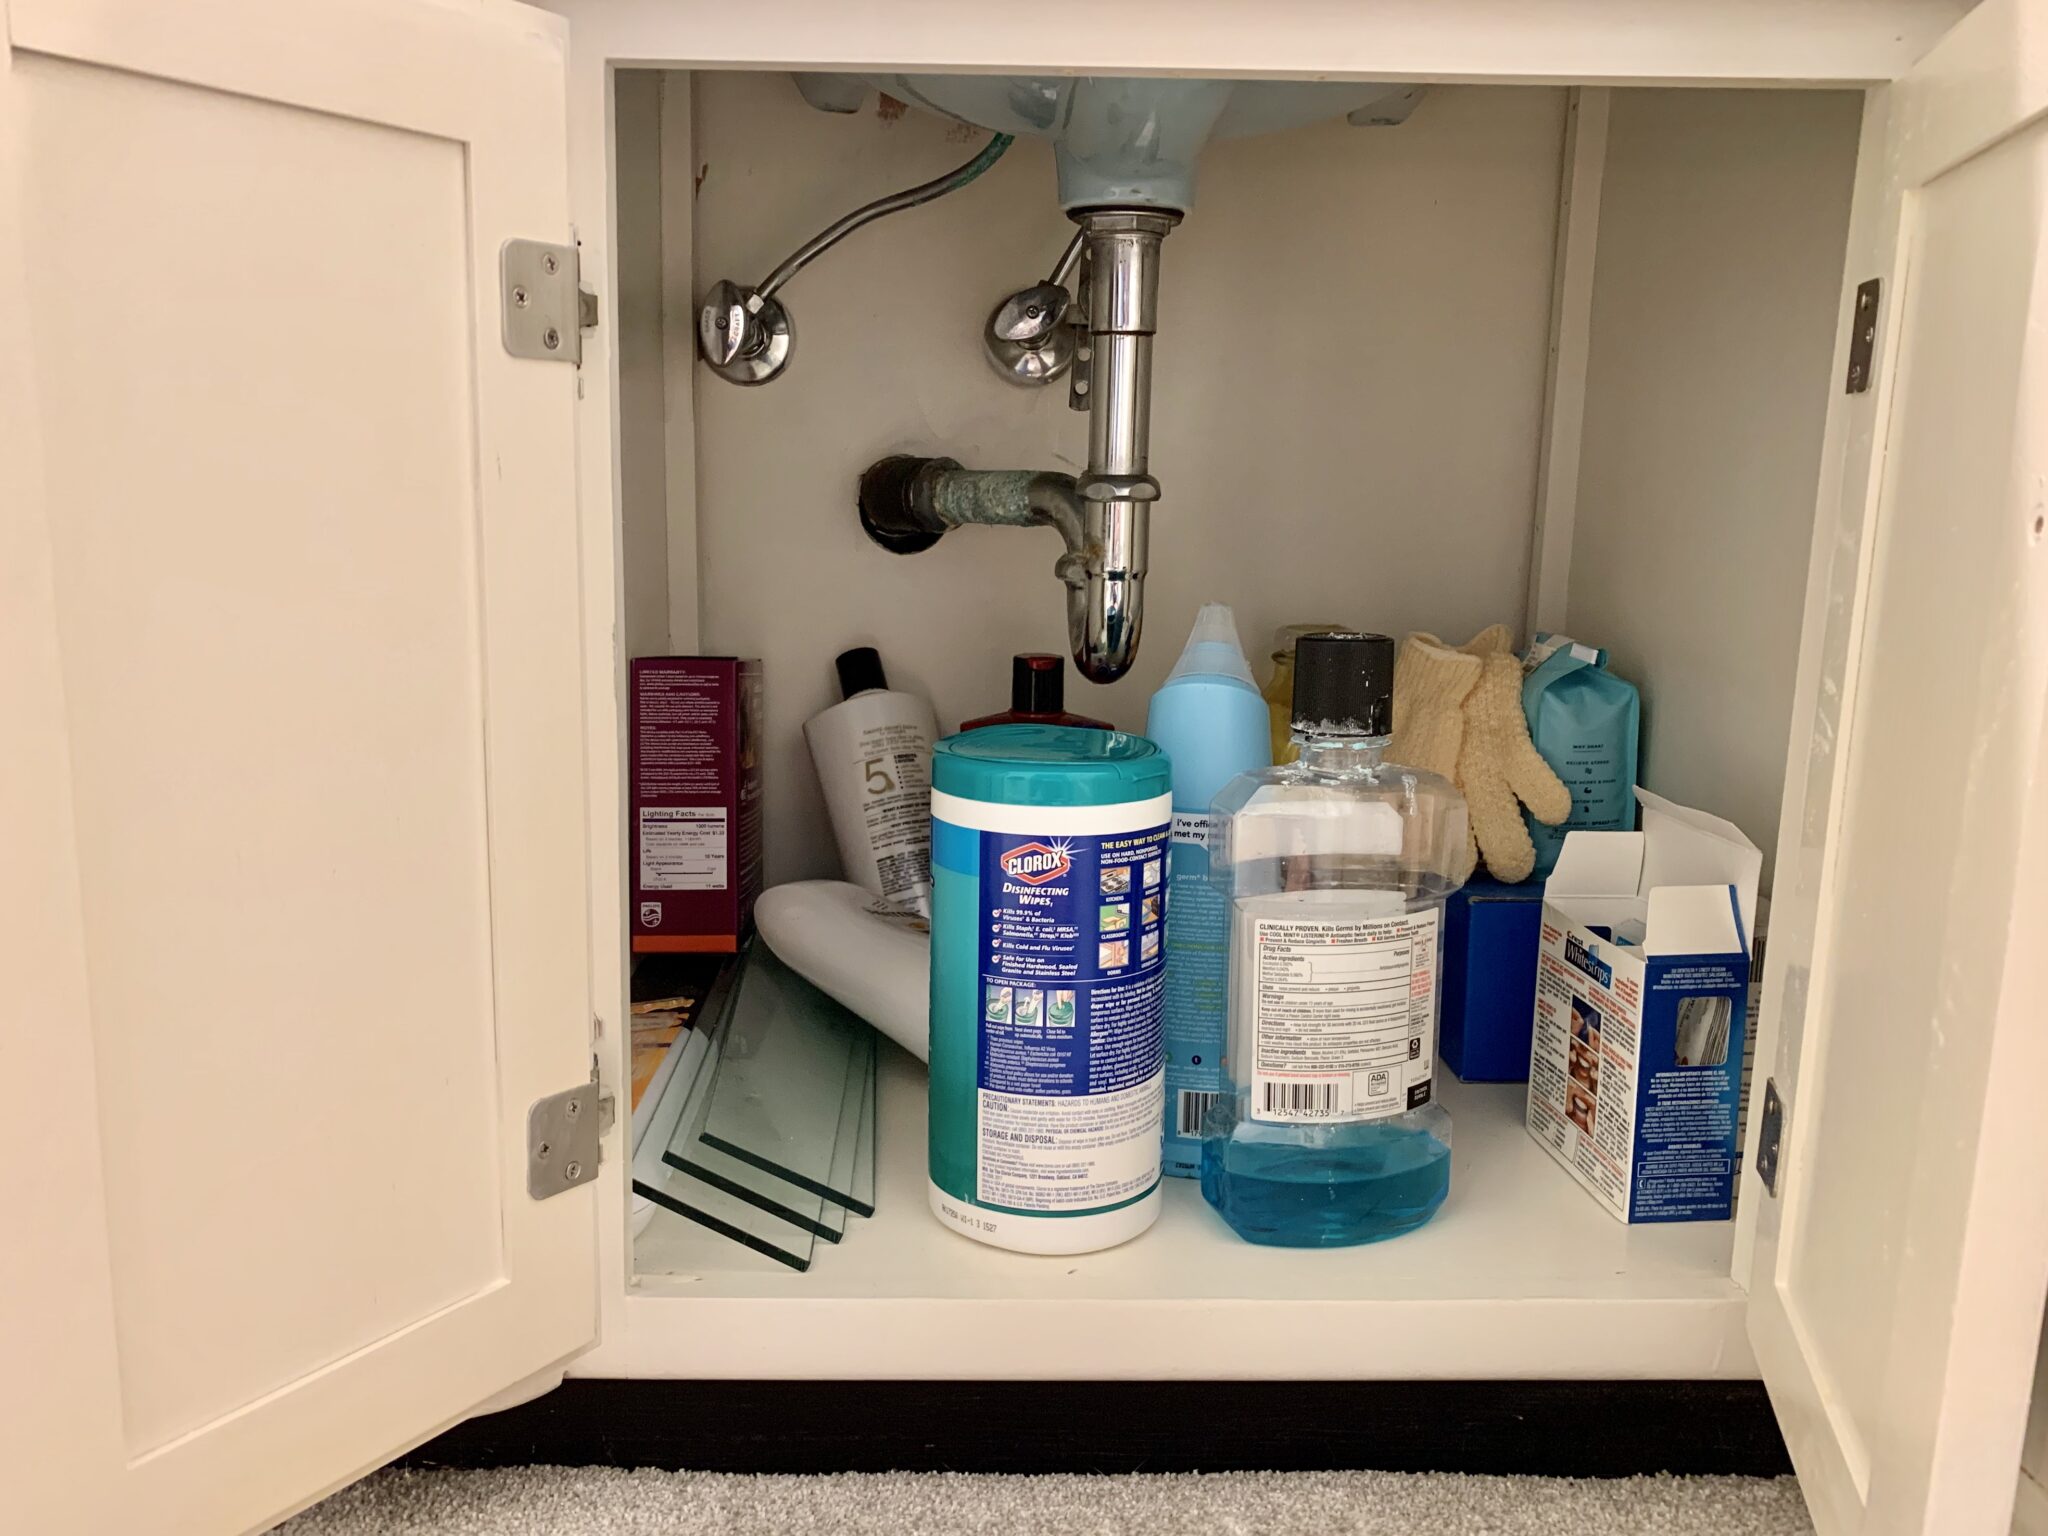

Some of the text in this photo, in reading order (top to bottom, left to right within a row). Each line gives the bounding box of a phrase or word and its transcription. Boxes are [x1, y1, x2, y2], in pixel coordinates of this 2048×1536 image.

[642, 810, 674, 818] Lighting
[1192, 832, 1206, 841] my
[1101, 842, 1114, 850] THE
[1115, 840, 1132, 849] EASY
[1133, 837, 1146, 846] WAY
[1007, 851, 1064, 876] CLOROX
[1002, 882, 1070, 896] DISINFECTING
[1567, 930, 1584, 946] Crest
[1263, 945, 1276, 953] Drug
[1002, 961, 1026, 969] Finished
[1567, 942, 1611, 985] Whitestrips
[1009, 980, 1036, 988] PACKAGE:
[1371, 1073, 1386, 1082] ADA
[982, 1093, 1021, 1104] PRECAUTIONARY
[1022, 1098, 1056, 1107] STATEMENTS:
[1057, 1099, 1082, 1107] HAZARDS
[1090, 1097, 1110, 1106] HUMANS
[1111, 1095, 1120, 1103] AND
[982, 1128, 1058, 1144] STORAGE AND DISPOSAL:
[983, 1222, 997, 1232] 1527
